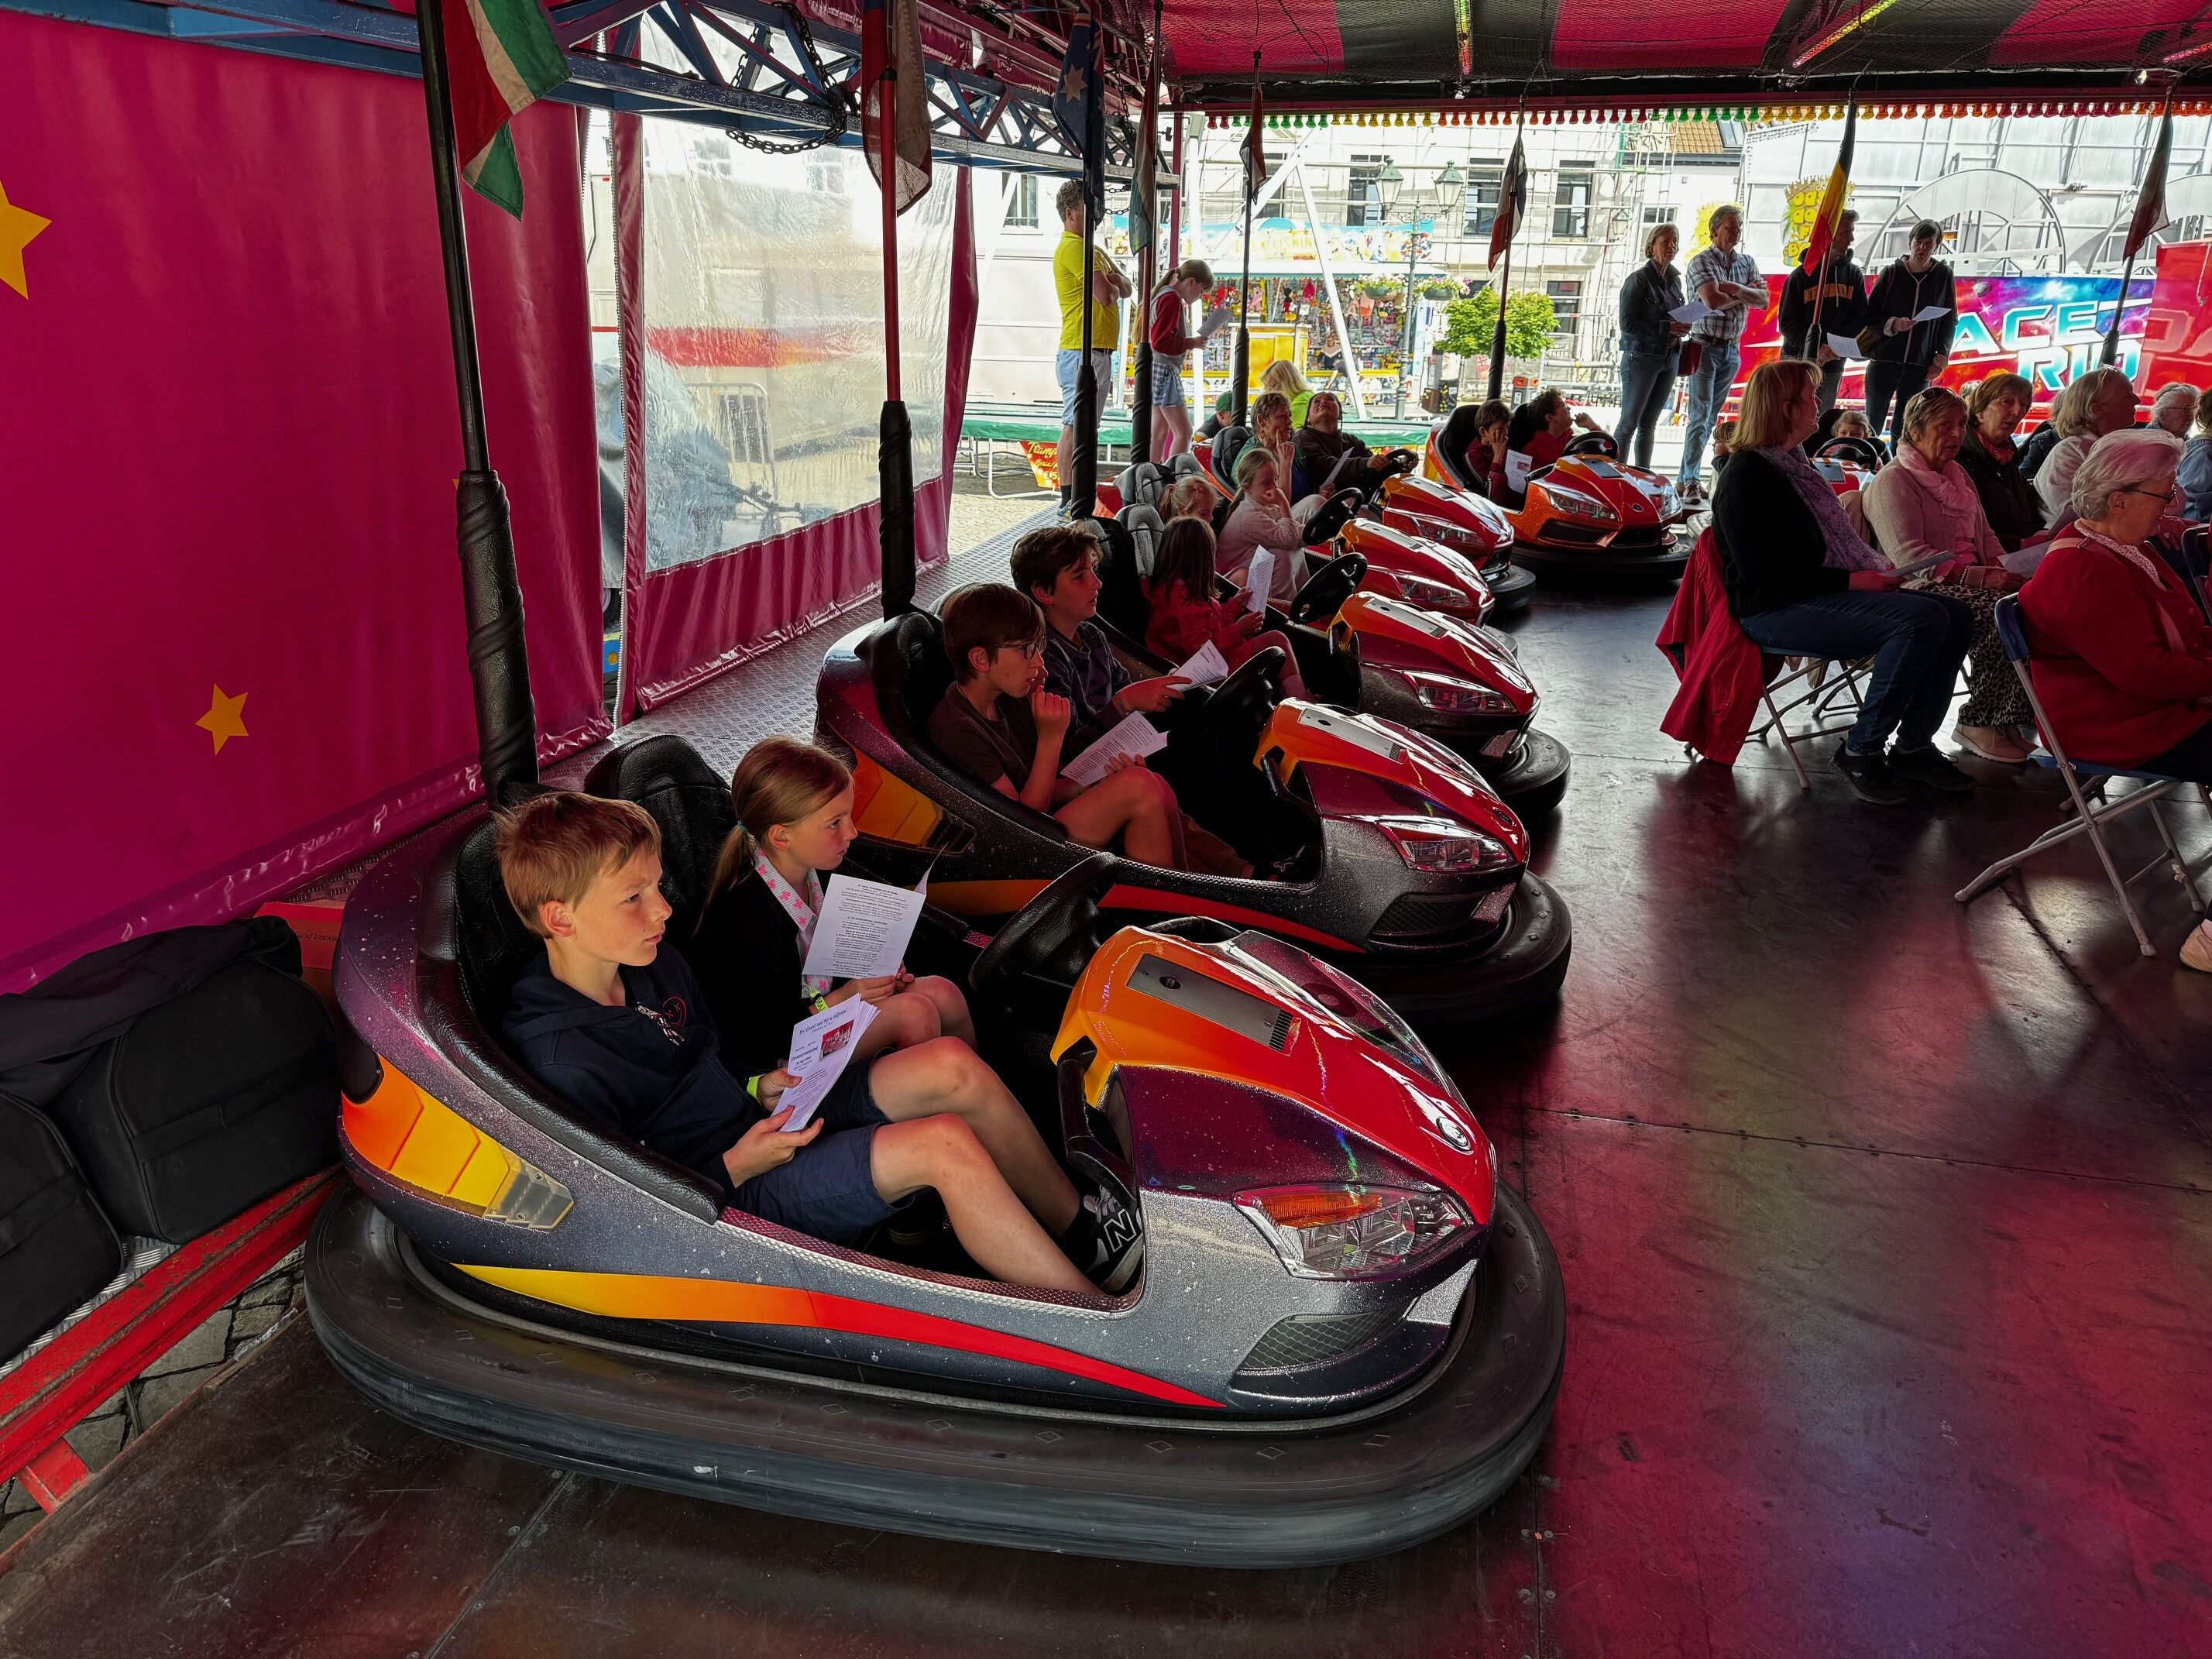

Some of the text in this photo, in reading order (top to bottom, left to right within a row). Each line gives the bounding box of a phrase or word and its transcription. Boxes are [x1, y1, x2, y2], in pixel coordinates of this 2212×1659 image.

[1952, 301, 2105, 354] ACE
[2017, 339, 2142, 391] RID
[1028, 442, 1058, 458] Tramp
